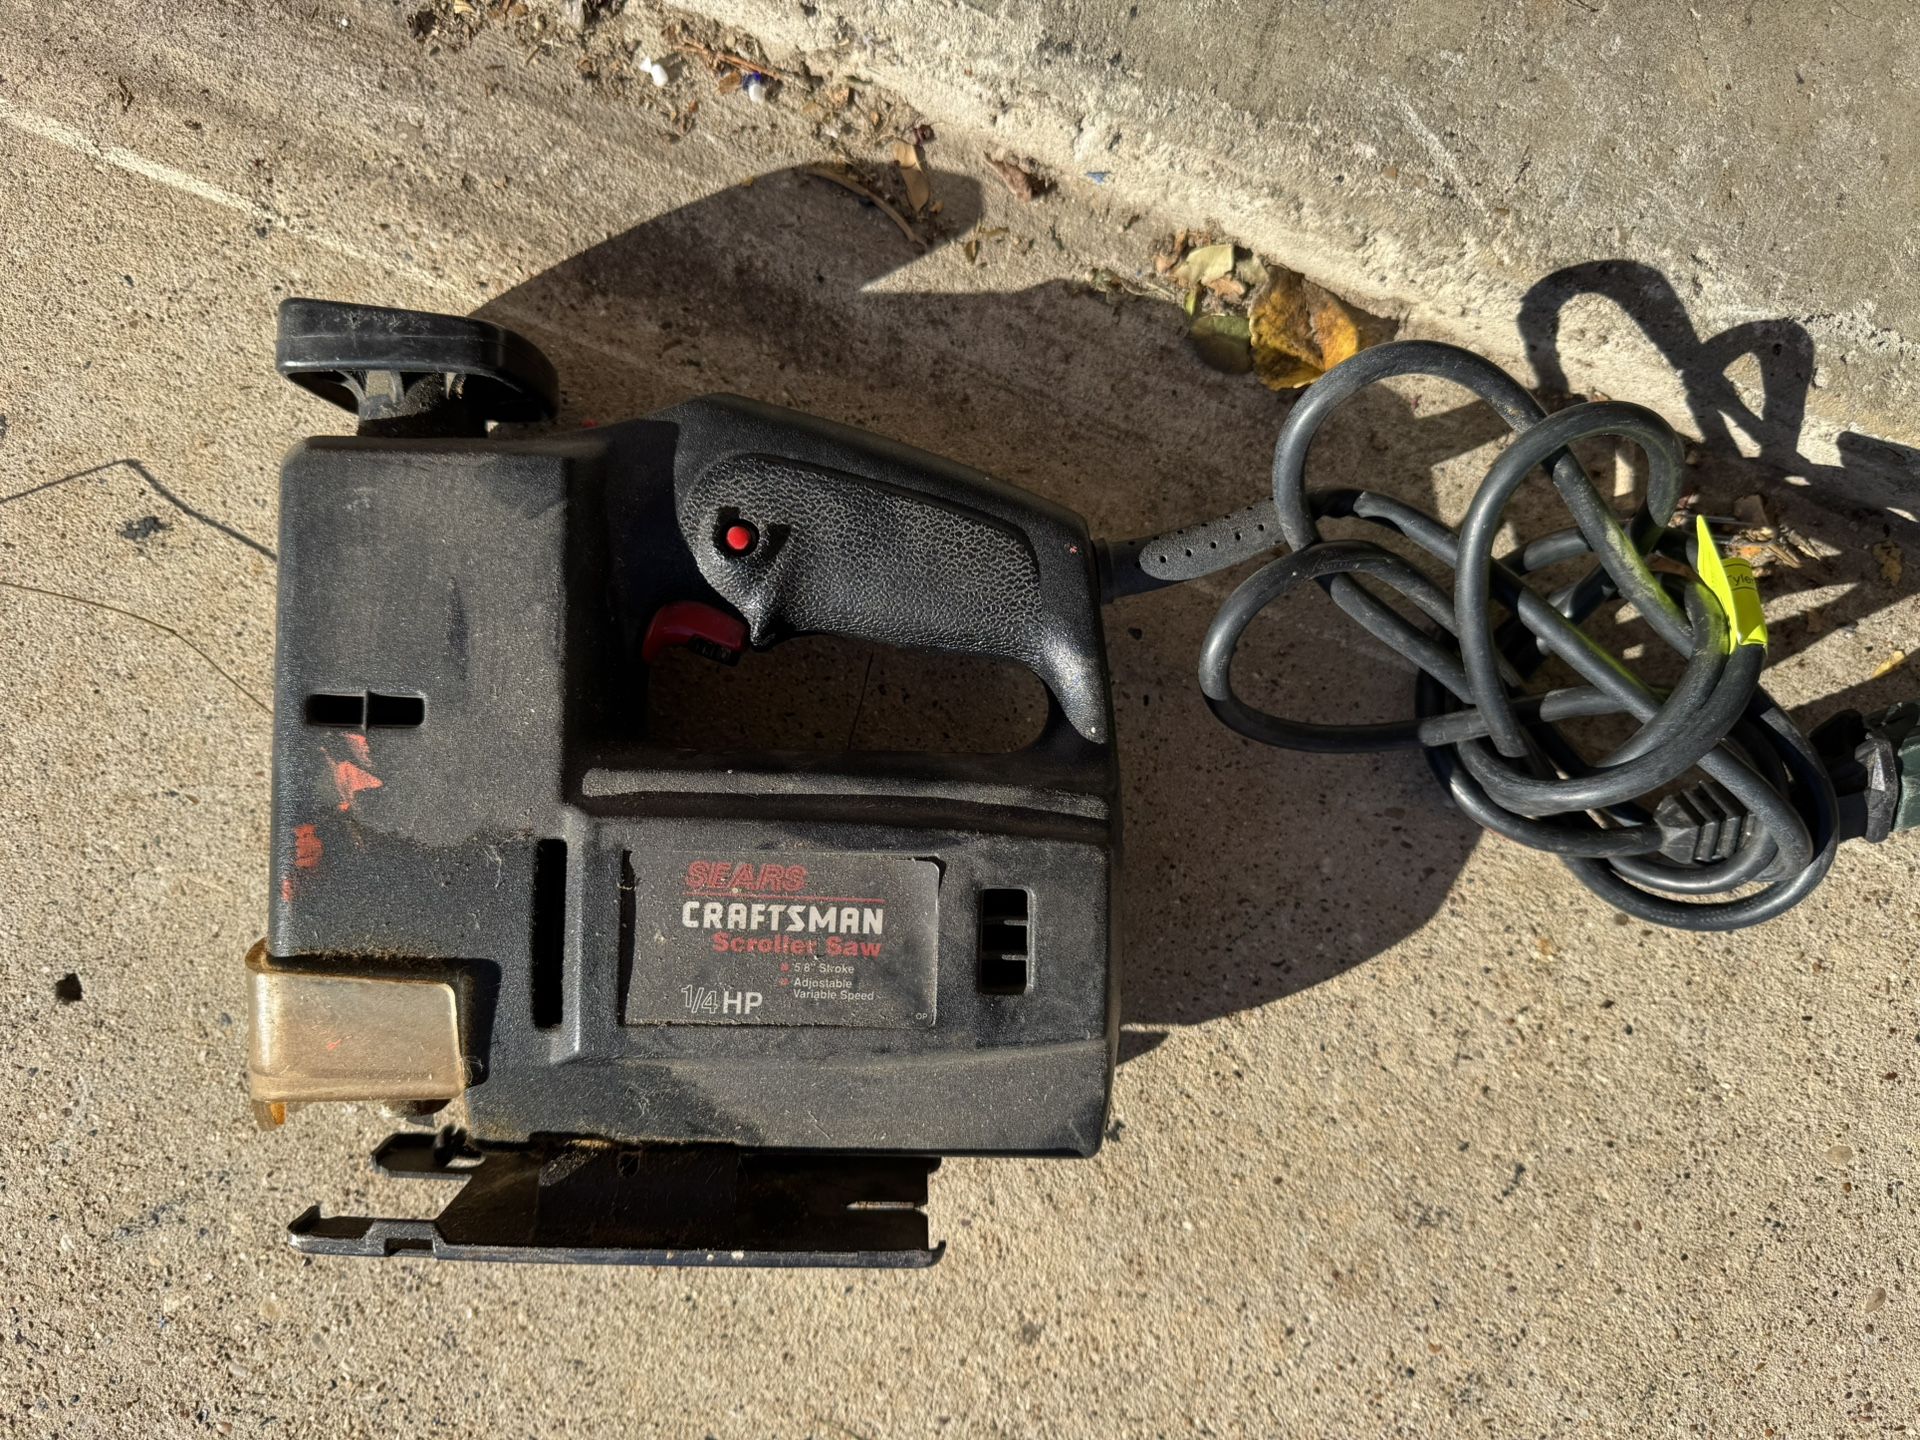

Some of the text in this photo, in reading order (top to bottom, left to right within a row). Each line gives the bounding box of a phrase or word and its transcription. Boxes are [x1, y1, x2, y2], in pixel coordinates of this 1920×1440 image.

[686, 860, 808, 892] SEARS
[682, 901, 884, 935] CRAFTSMAN
[713, 931, 882, 958] Scroller Saw
[794, 962, 855, 974] 58" Stroke
[793, 977, 853, 989] Adjustable
[793, 988, 875, 1002] Variable Speed
[681, 984, 763, 1015] 1/4 HP
